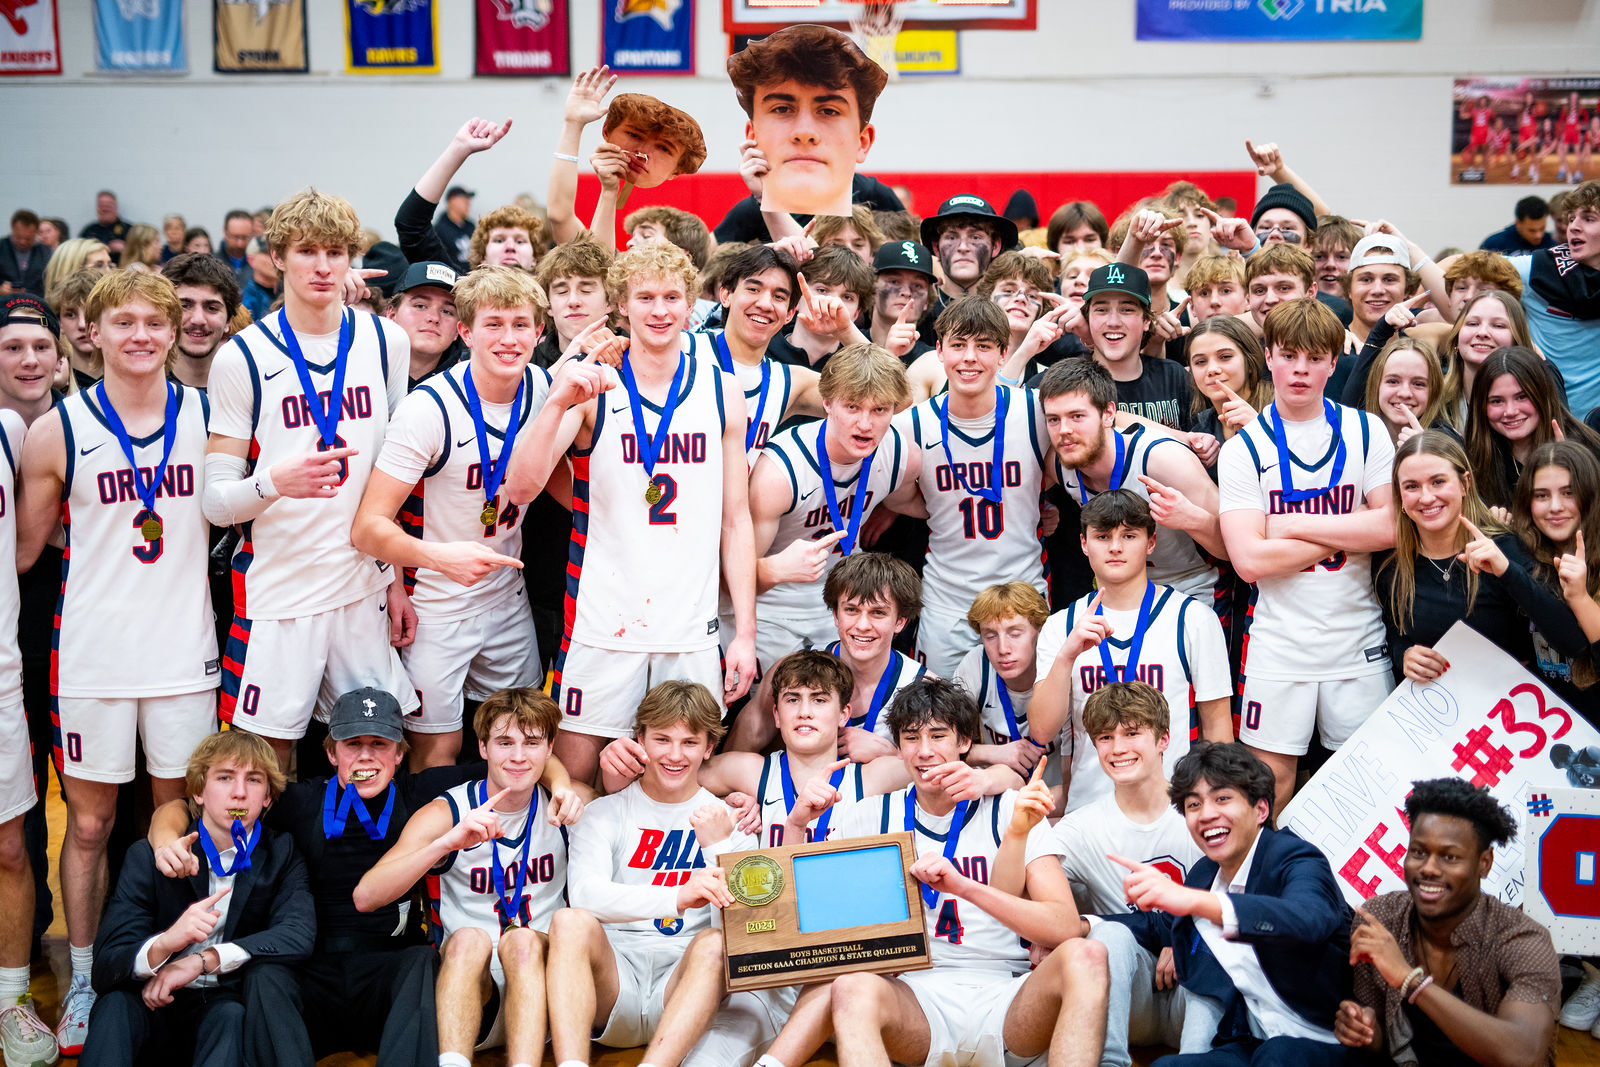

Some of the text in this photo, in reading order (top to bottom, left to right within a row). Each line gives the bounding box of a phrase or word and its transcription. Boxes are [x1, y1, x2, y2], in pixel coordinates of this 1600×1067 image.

[1316, 0, 1388, 14] TRIA
[1106, 264, 1125, 284] LA
[97, 464, 195, 505] ORONO
[648, 473, 678, 525] 2
[132, 509, 164, 564] 3
[958, 496, 1005, 540] 10
[1387, 680, 1459, 754] NO
[1450, 682, 1573, 788] #33
[748, 920, 775, 933] 2024
[934, 898, 964, 945] 4
[738, 945, 917, 973] SECTION 6AAA CHAMPION & STATE QUALIFIER
[790, 943, 864, 959] BOYS BASKETBALL
